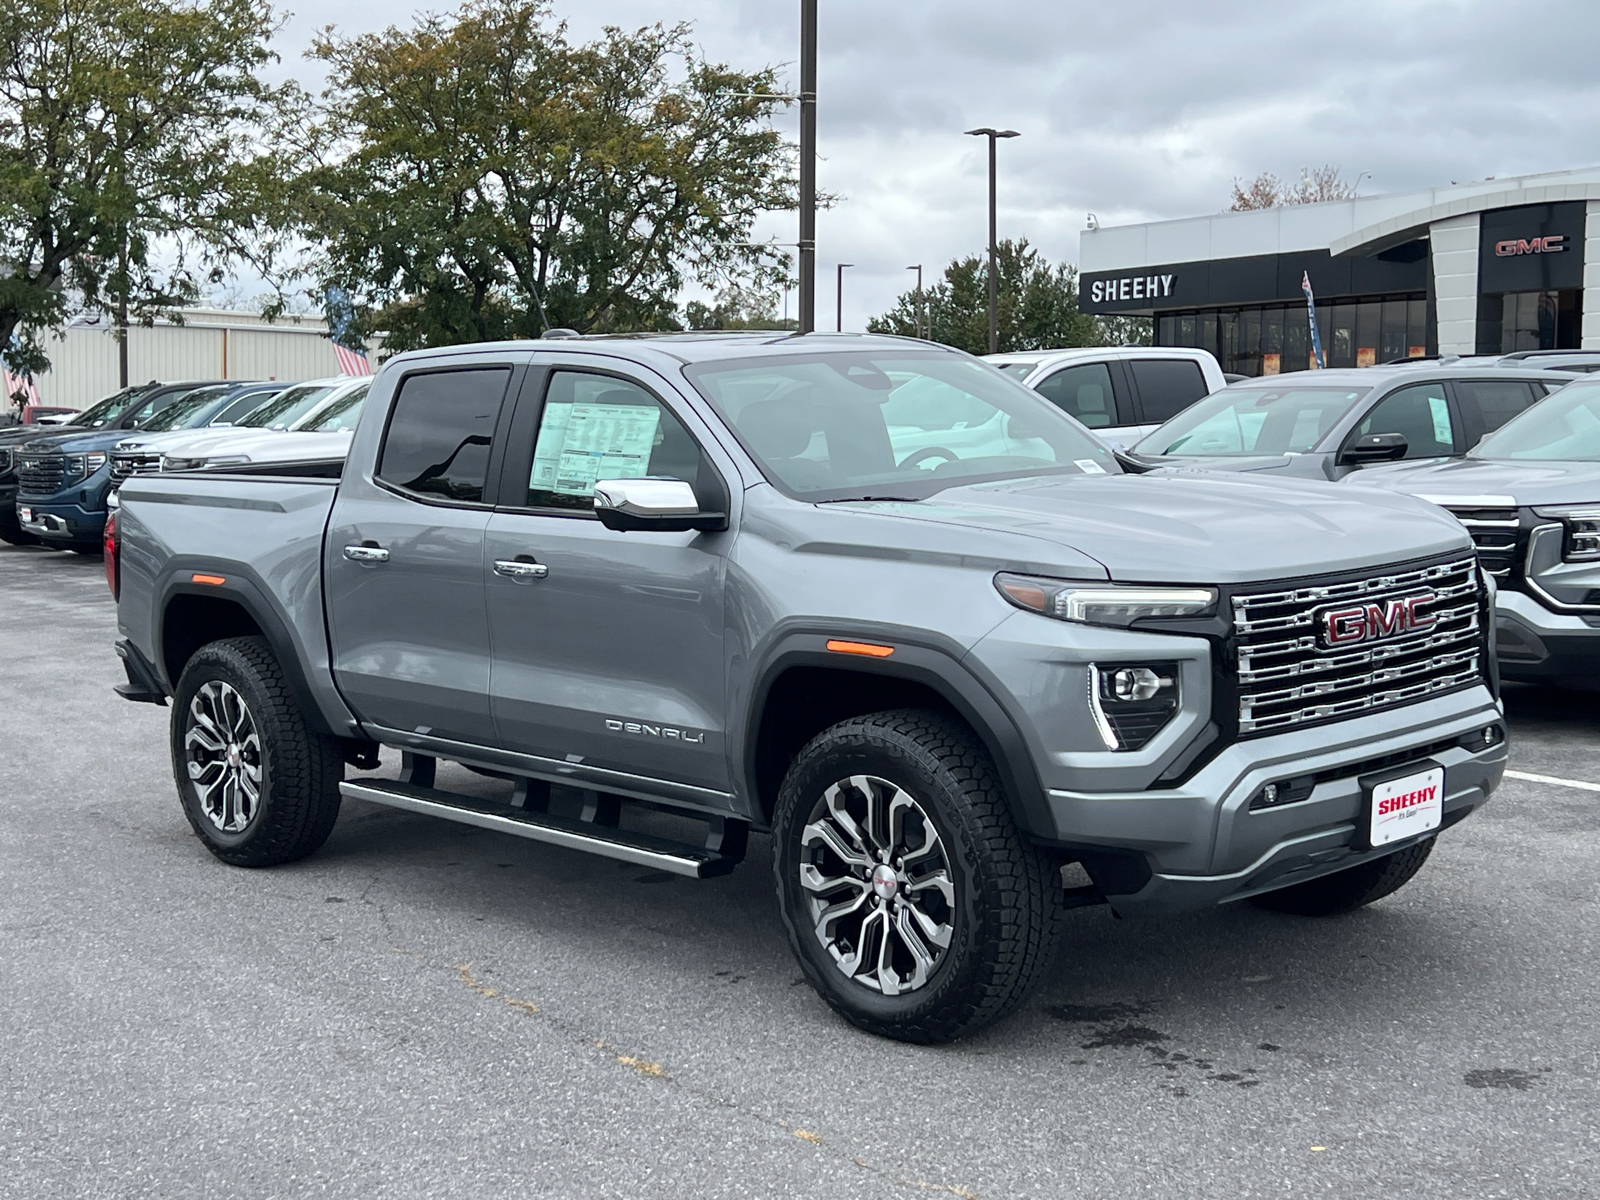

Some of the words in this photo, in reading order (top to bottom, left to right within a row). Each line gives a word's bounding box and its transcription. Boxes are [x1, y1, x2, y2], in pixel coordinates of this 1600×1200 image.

[1495, 235, 1564, 257] GMC
[1091, 274, 1173, 303] SHEEHY
[1325, 593, 1438, 646] GMC
[605, 719, 705, 744] DENALI
[1378, 785, 1437, 815] SHEEHY
